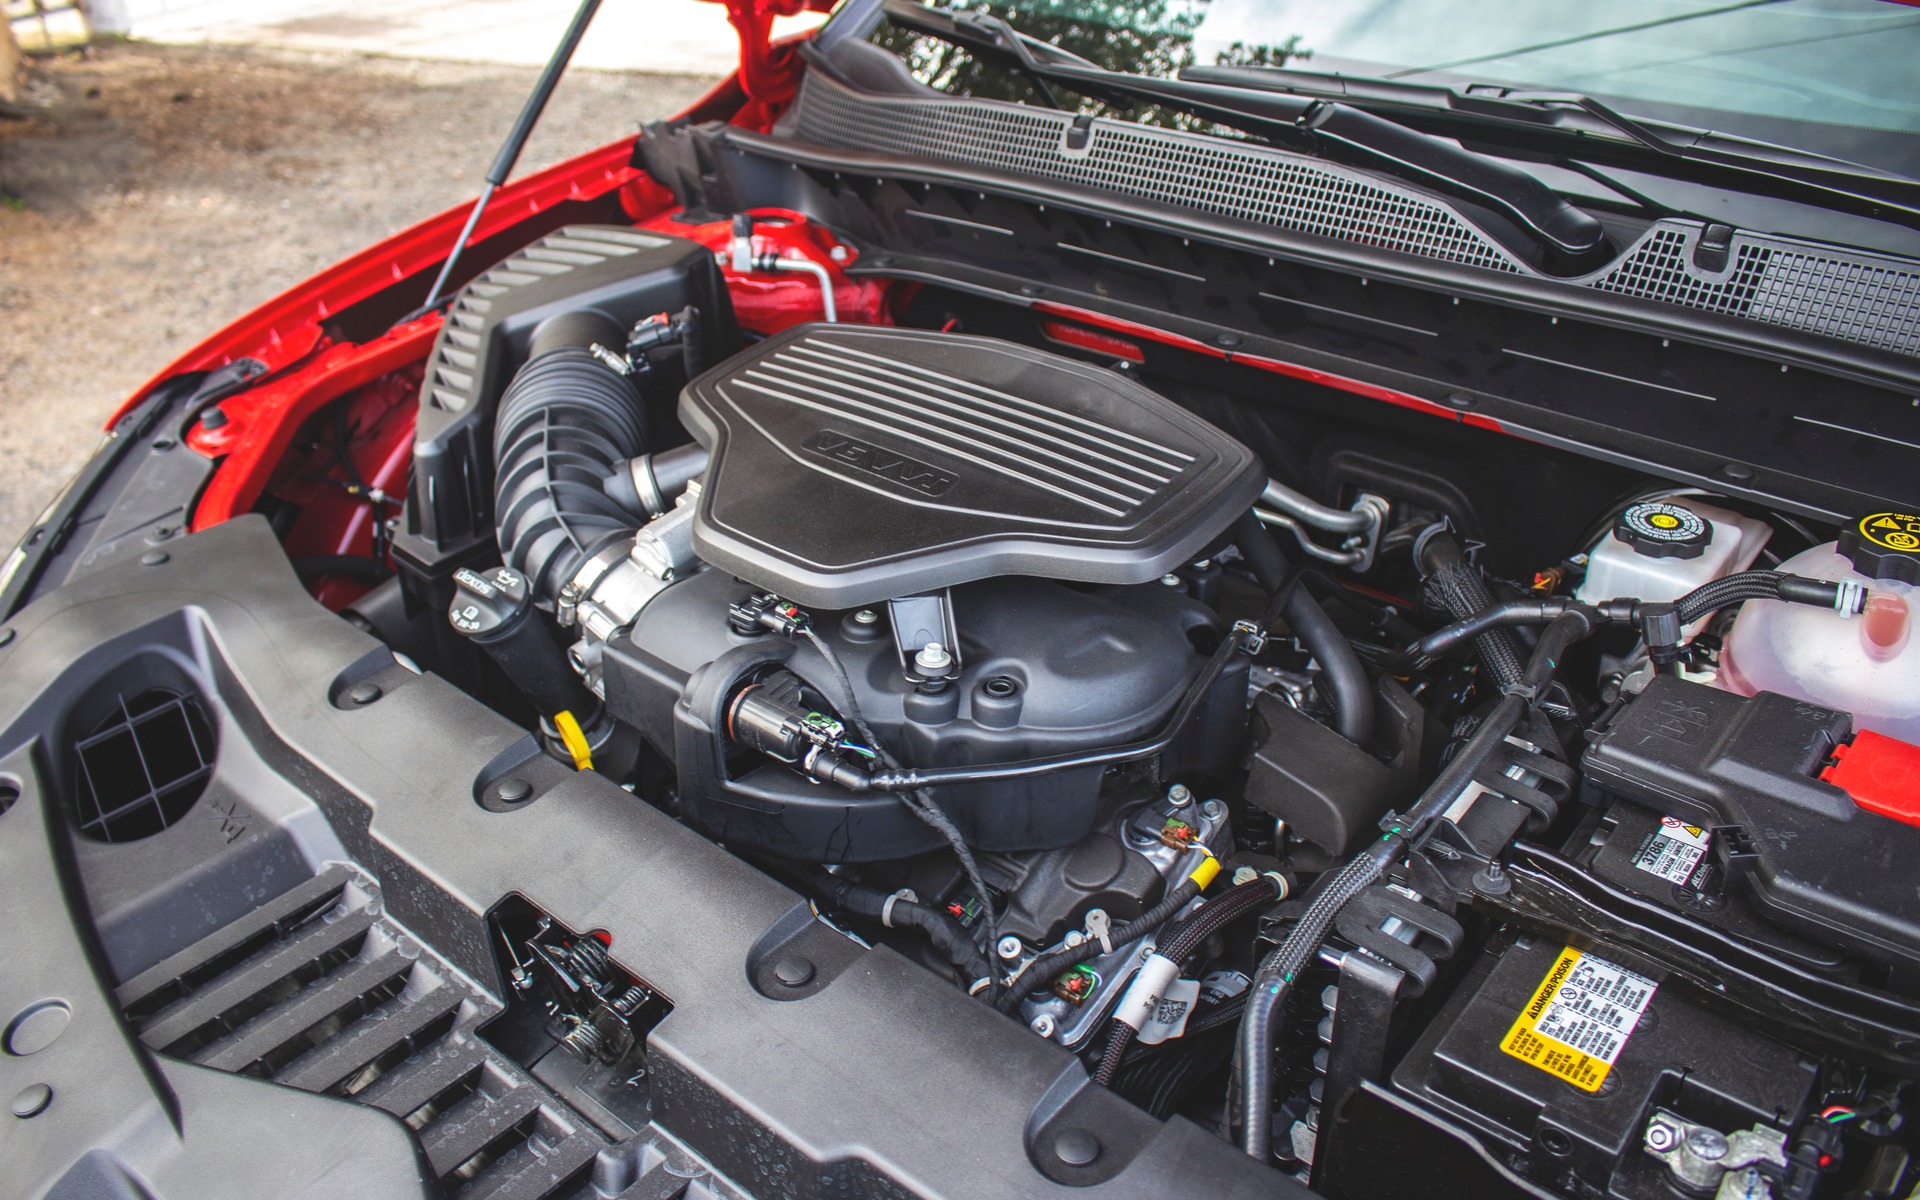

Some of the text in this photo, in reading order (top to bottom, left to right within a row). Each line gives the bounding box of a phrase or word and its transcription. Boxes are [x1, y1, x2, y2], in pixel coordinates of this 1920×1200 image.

[455, 569, 493, 595] dexos
[1642, 841, 1666, 865] 3786
[1532, 957, 1573, 1015] DANGER/POISON
